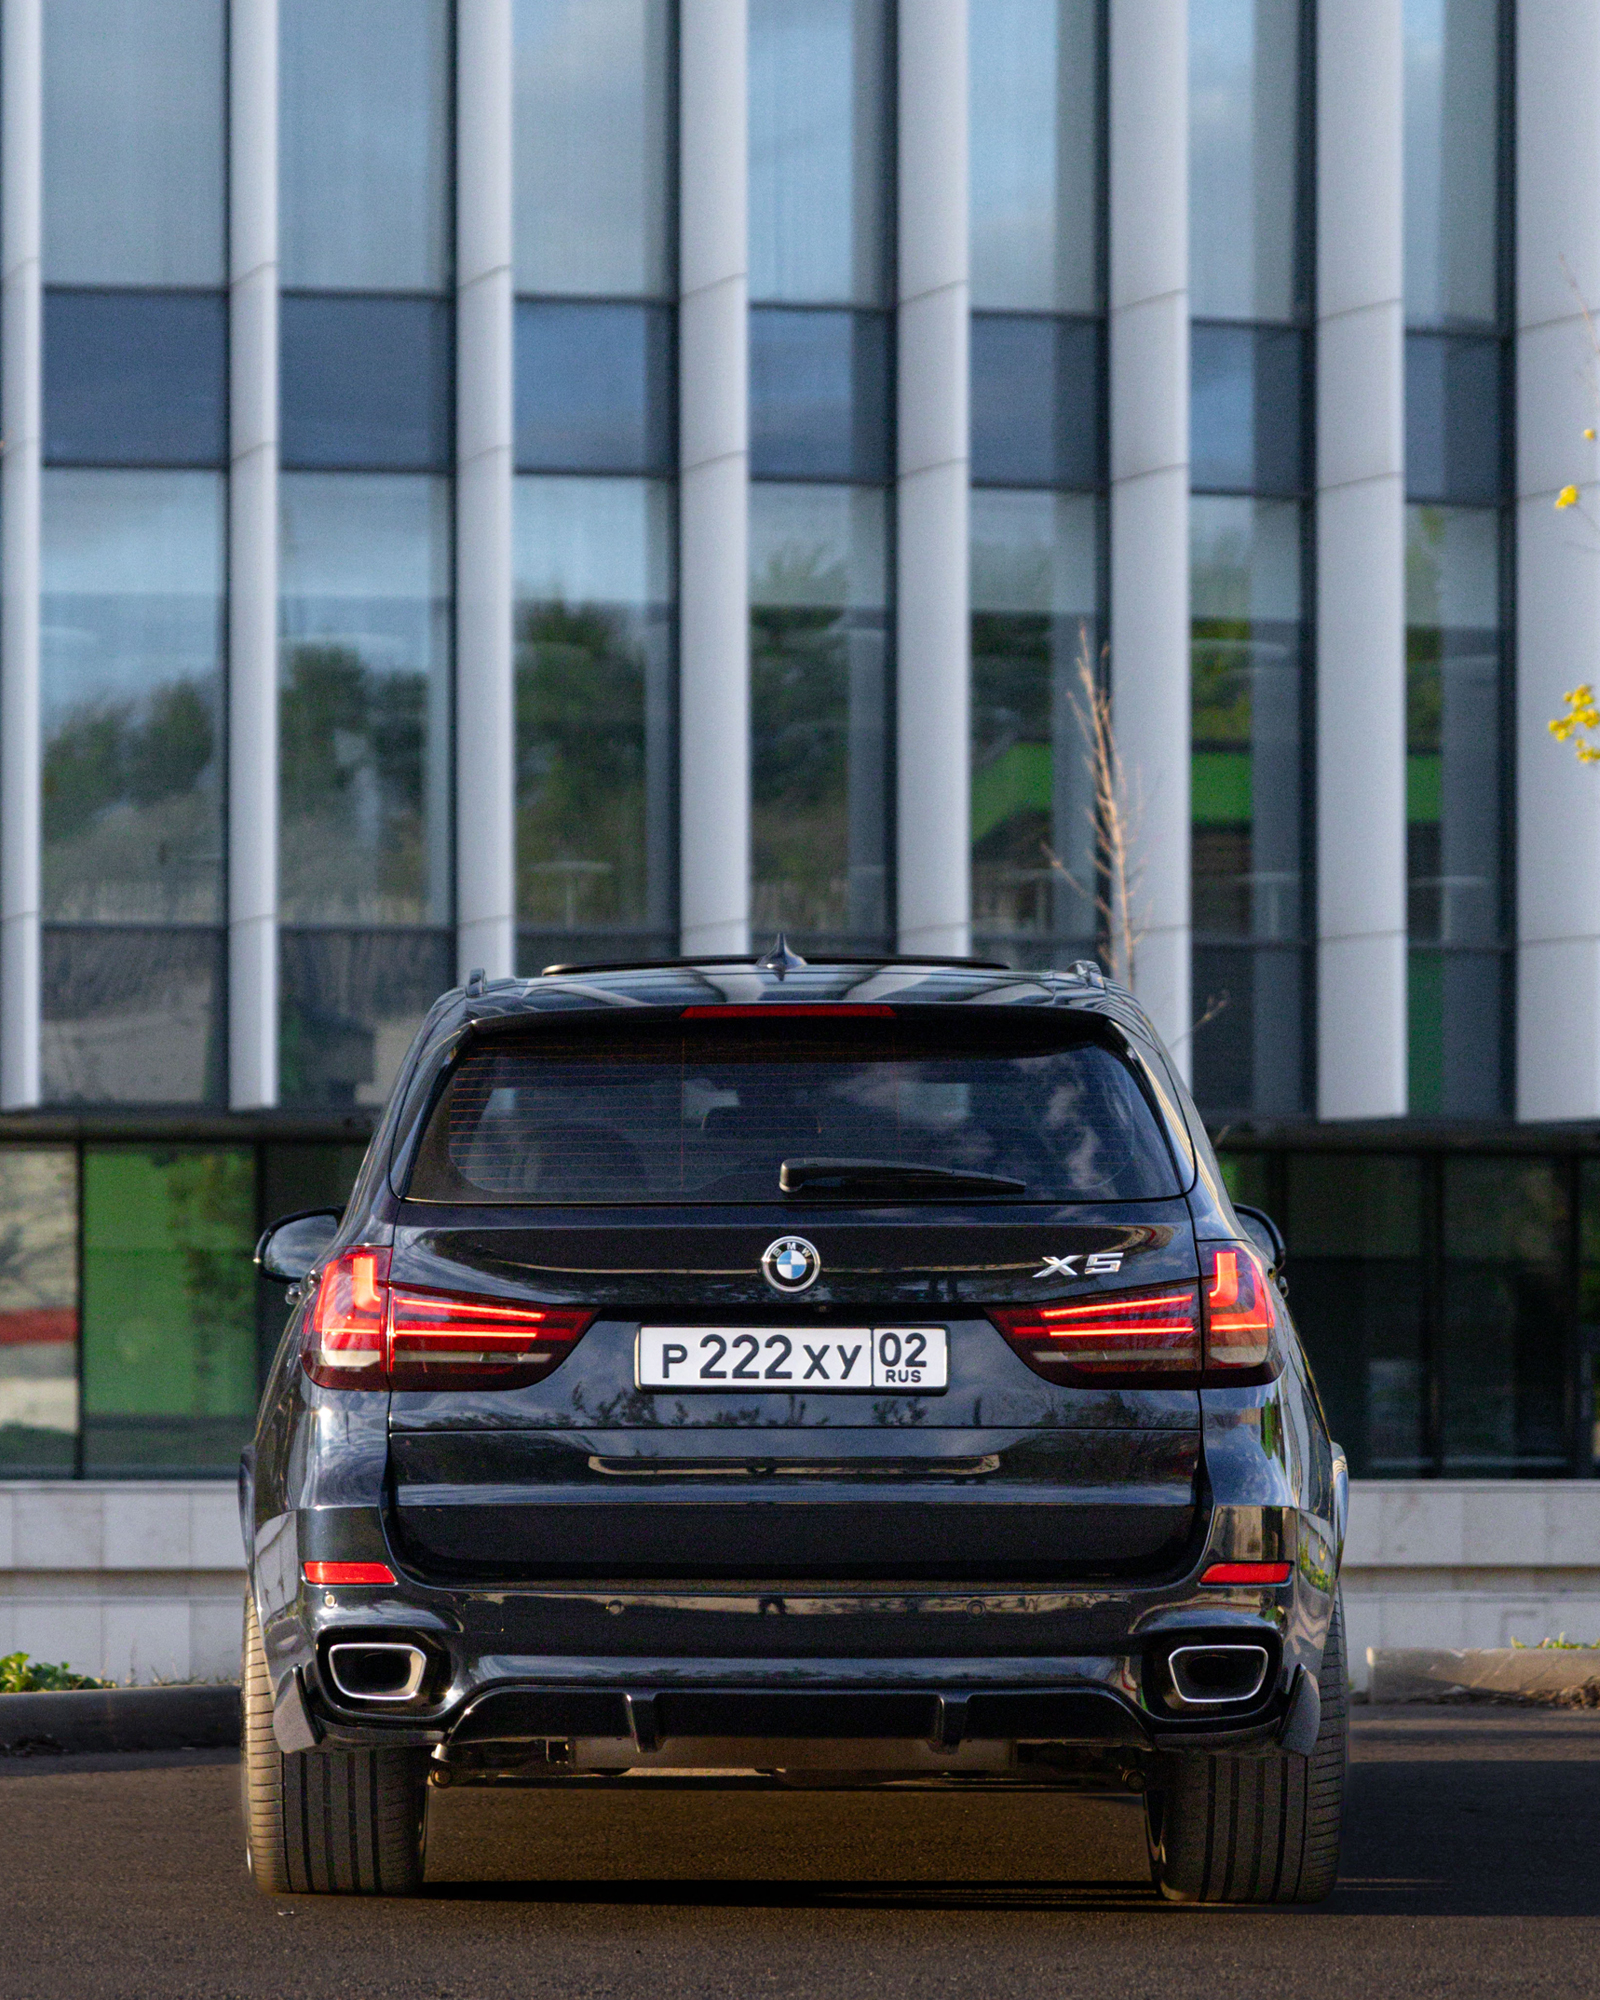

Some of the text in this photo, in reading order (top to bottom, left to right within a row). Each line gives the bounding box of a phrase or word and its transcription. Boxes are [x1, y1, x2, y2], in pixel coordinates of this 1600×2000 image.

[772, 1242, 811, 1257] BMW
[1032, 1252, 1124, 1278] X5
[878, 1332, 927, 1368] 02
[885, 1369, 922, 1383] RUS
